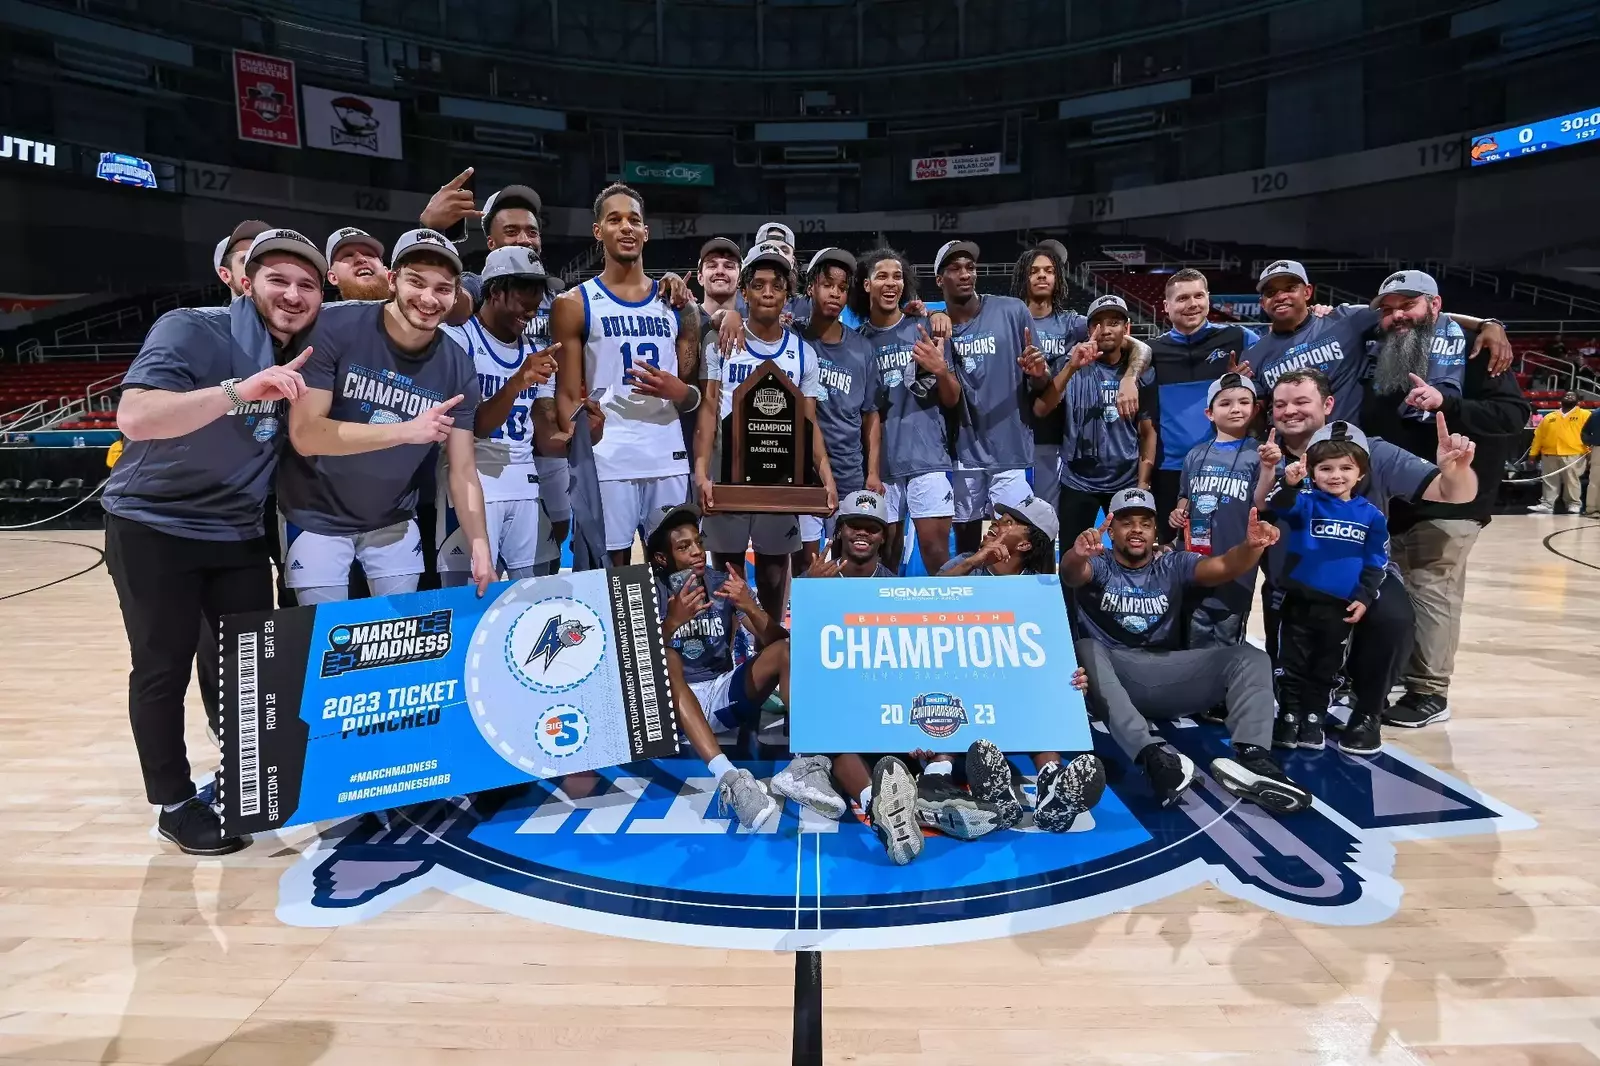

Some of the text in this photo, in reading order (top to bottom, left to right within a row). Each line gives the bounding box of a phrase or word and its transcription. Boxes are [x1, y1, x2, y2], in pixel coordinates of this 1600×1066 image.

[240, 58, 288, 72] CHARLOTTE
[240, 64, 288, 80] CHECKERS
[1518, 128, 1533, 144] 0
[1575, 129, 1597, 139] 1ST
[917, 159, 947, 169] AUTO
[1418, 141, 1459, 166] 119
[190, 168, 232, 191] 127
[635, 165, 702, 182] Great Clips
[916, 170, 947, 179] WORLD
[1252, 172, 1288, 193] 120
[353, 190, 389, 211] 126
[1088, 197, 1114, 217] 121
[799, 219, 825, 234] 123
[601, 315, 671, 338] BULLDOGS
[1263, 341, 1345, 389] CHAMPIONS
[360, 402, 372, 413] 20
[748, 422, 792, 432] CHAMPION
[750, 446, 789, 454] BASKETBALL
[1221, 496, 1230, 504] 23
[1314, 522, 1366, 541] adidas
[879, 586, 974, 598] SIGNATURE
[1100, 592, 1169, 615] CHAMPIONS
[858, 614, 999, 623] BIG SOUTH
[264, 620, 275, 659] SEAT 23
[334, 634, 351, 642] NCAA
[351, 619, 418, 645] MARCH
[360, 633, 449, 662] MADNESS
[820, 622, 1046, 670] CHAMPIONS
[612, 575, 644, 754] NCAA TOURNAMENT AUTOMATIC QUALIFIER
[322, 679, 459, 720] 2023 TICKET
[266, 693, 276, 730] ROW 12
[341, 703, 441, 740] PUNCHED
[880, 704, 996, 725] 20 23
[545, 721, 563, 730] BIG
[554, 713, 579, 747] S
[349, 759, 438, 783] #MARCHMADNESS
[267, 765, 279, 821] SECTION 3
[337, 773, 451, 803] @MARCHMADNESSMBB
